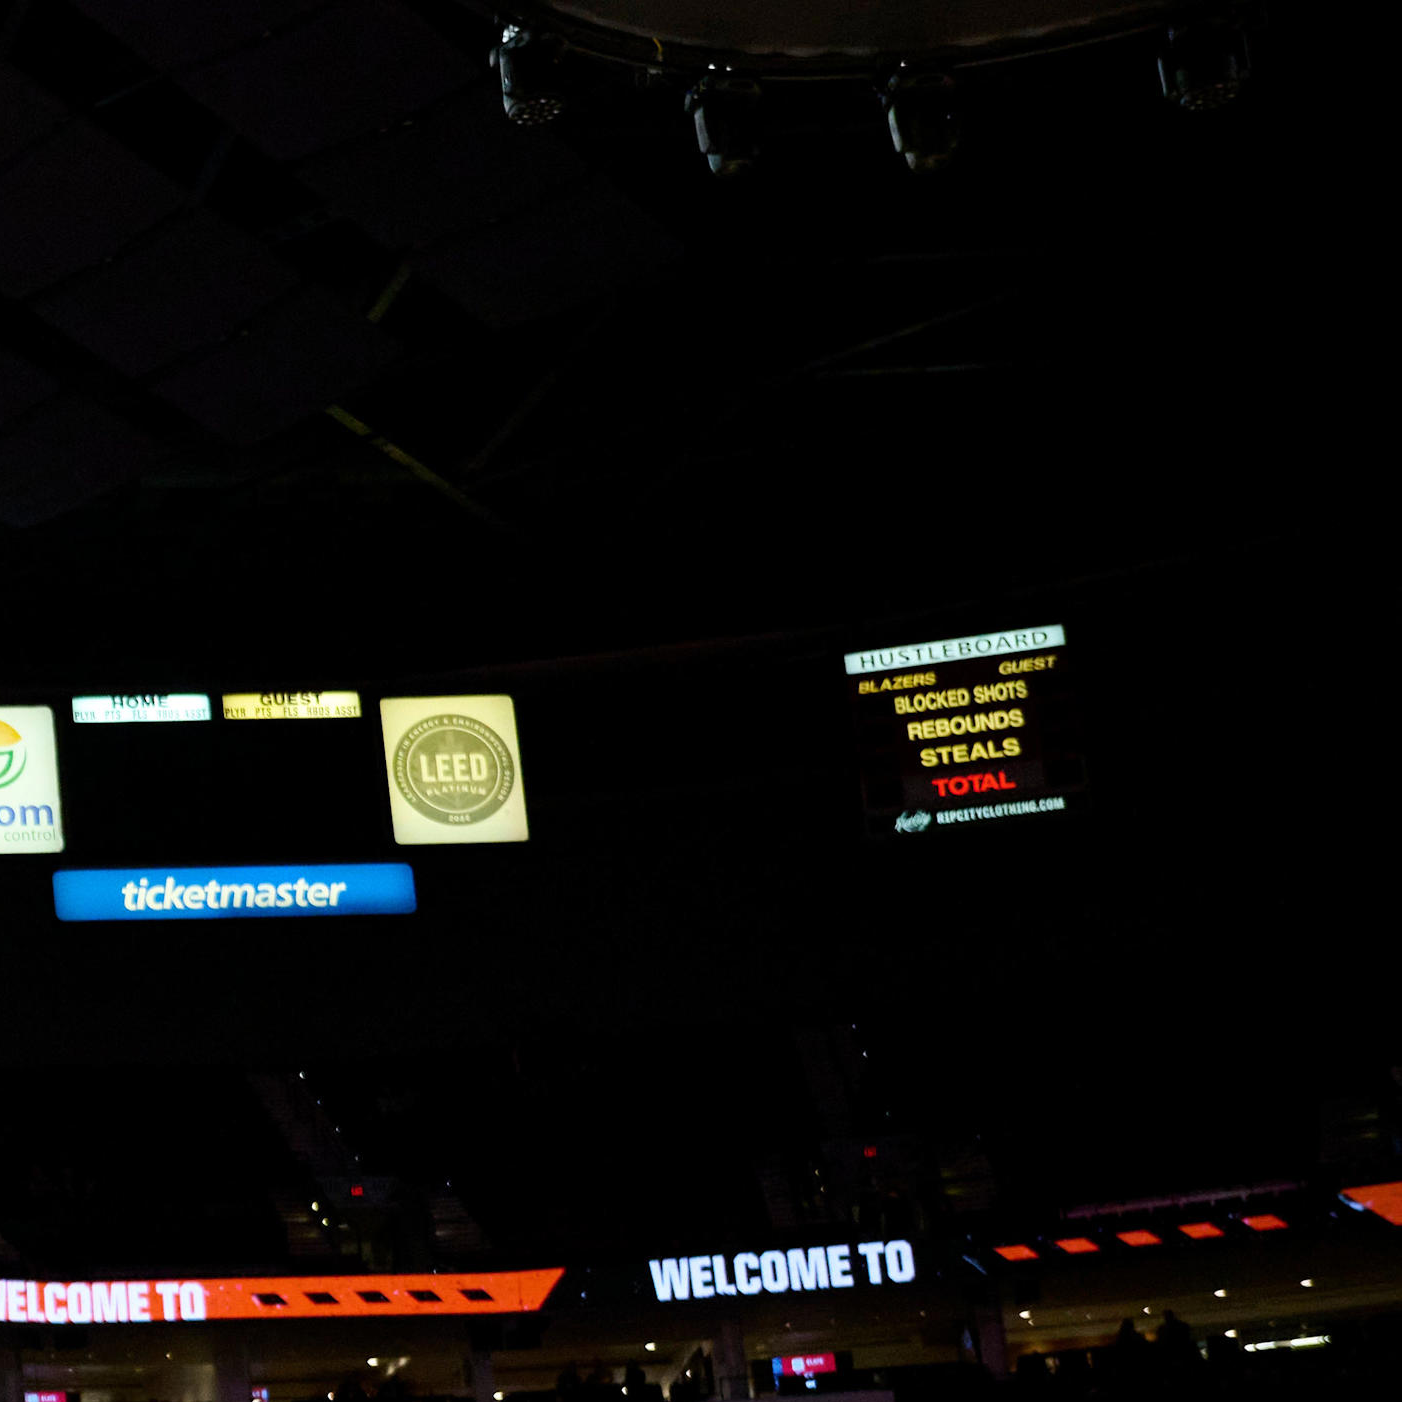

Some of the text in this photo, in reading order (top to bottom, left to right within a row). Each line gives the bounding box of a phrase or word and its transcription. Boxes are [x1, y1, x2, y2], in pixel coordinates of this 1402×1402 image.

[859, 630, 1049, 670] HUSTLEBOARD
[858, 655, 1058, 695] BLAZERS GUEST
[112, 695, 169, 709] HOME
[259, 692, 323, 706] GUEST
[894, 680, 1029, 715] BLOCKED SHOTS
[907, 708, 1025, 741] REBOUNDS
[420, 752, 488, 783] LEED
[920, 737, 1022, 767] STEALS
[426, 785, 487, 797] PLATINUM
[931, 770, 1017, 797] TOTAL
[936, 797, 1066, 825] RIPCITYCLOTHING.COM
[3, 827, 57, 842] control
[122, 877, 347, 912] ticketmaster
[649, 1239, 917, 1303] WELCOME TO
[156, 1282, 207, 1321] TO
